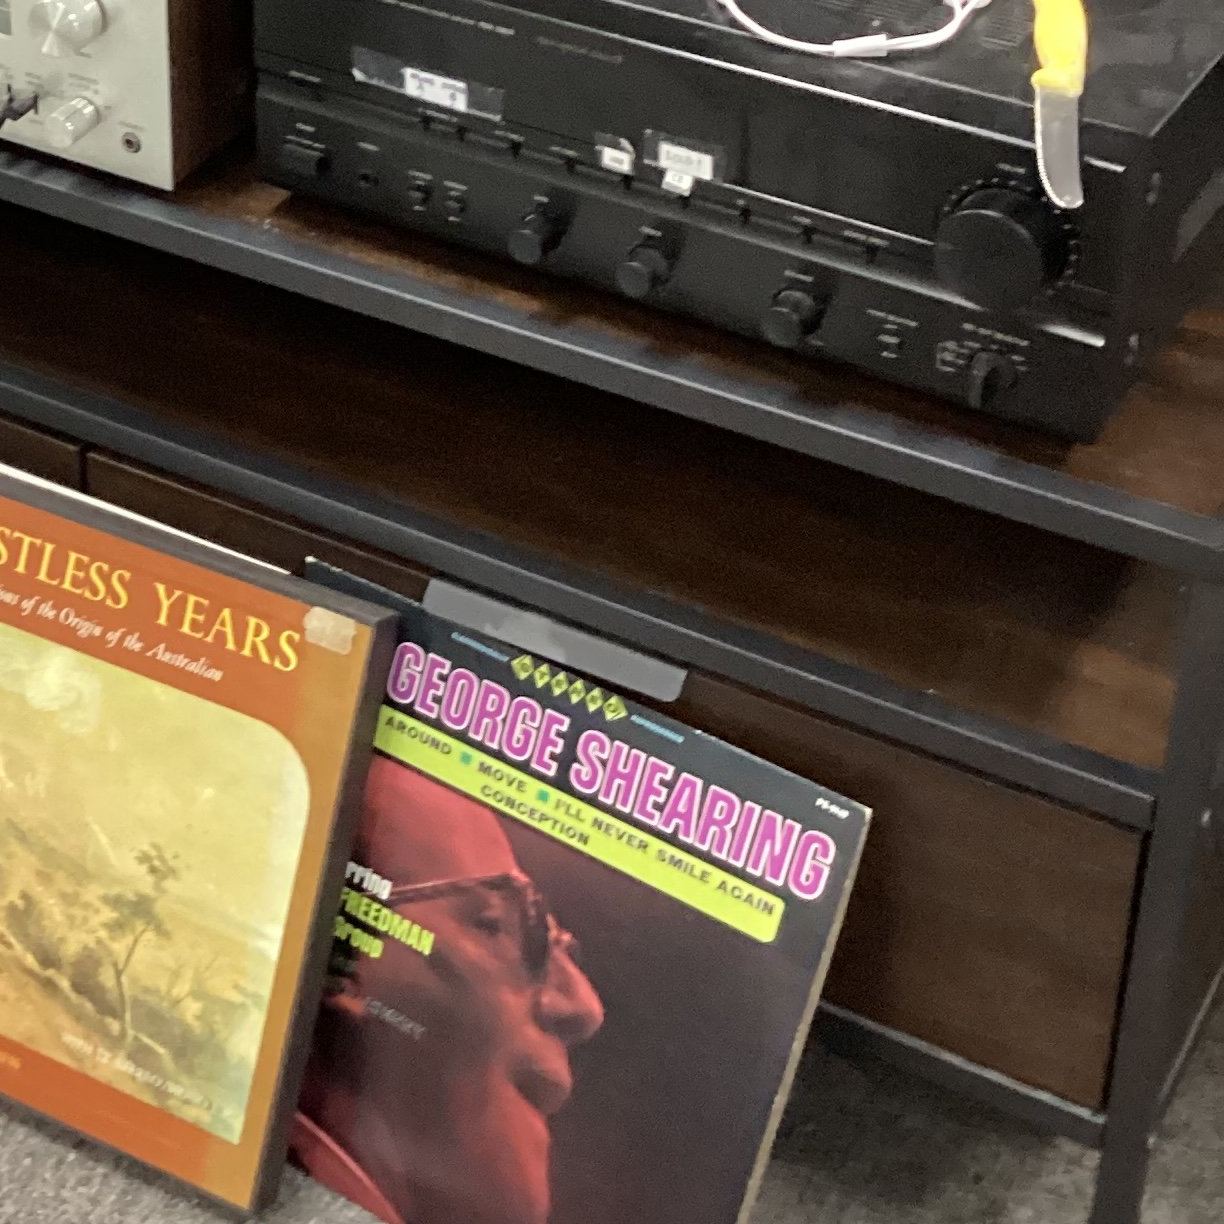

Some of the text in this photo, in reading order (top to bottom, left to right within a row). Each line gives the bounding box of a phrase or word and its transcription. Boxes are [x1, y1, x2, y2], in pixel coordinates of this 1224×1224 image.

[58, 606, 103, 639] Origin
[146, 642, 224, 682] Australian
[152, 581, 301, 672] YEARS
[385, 716, 777, 916] AROUND MOVE I'LL NEVER SMILE AGAIN
[386, 641, 836, 901] GEORGE SHEARING
[479, 784, 591, 846] CONCEPTION
